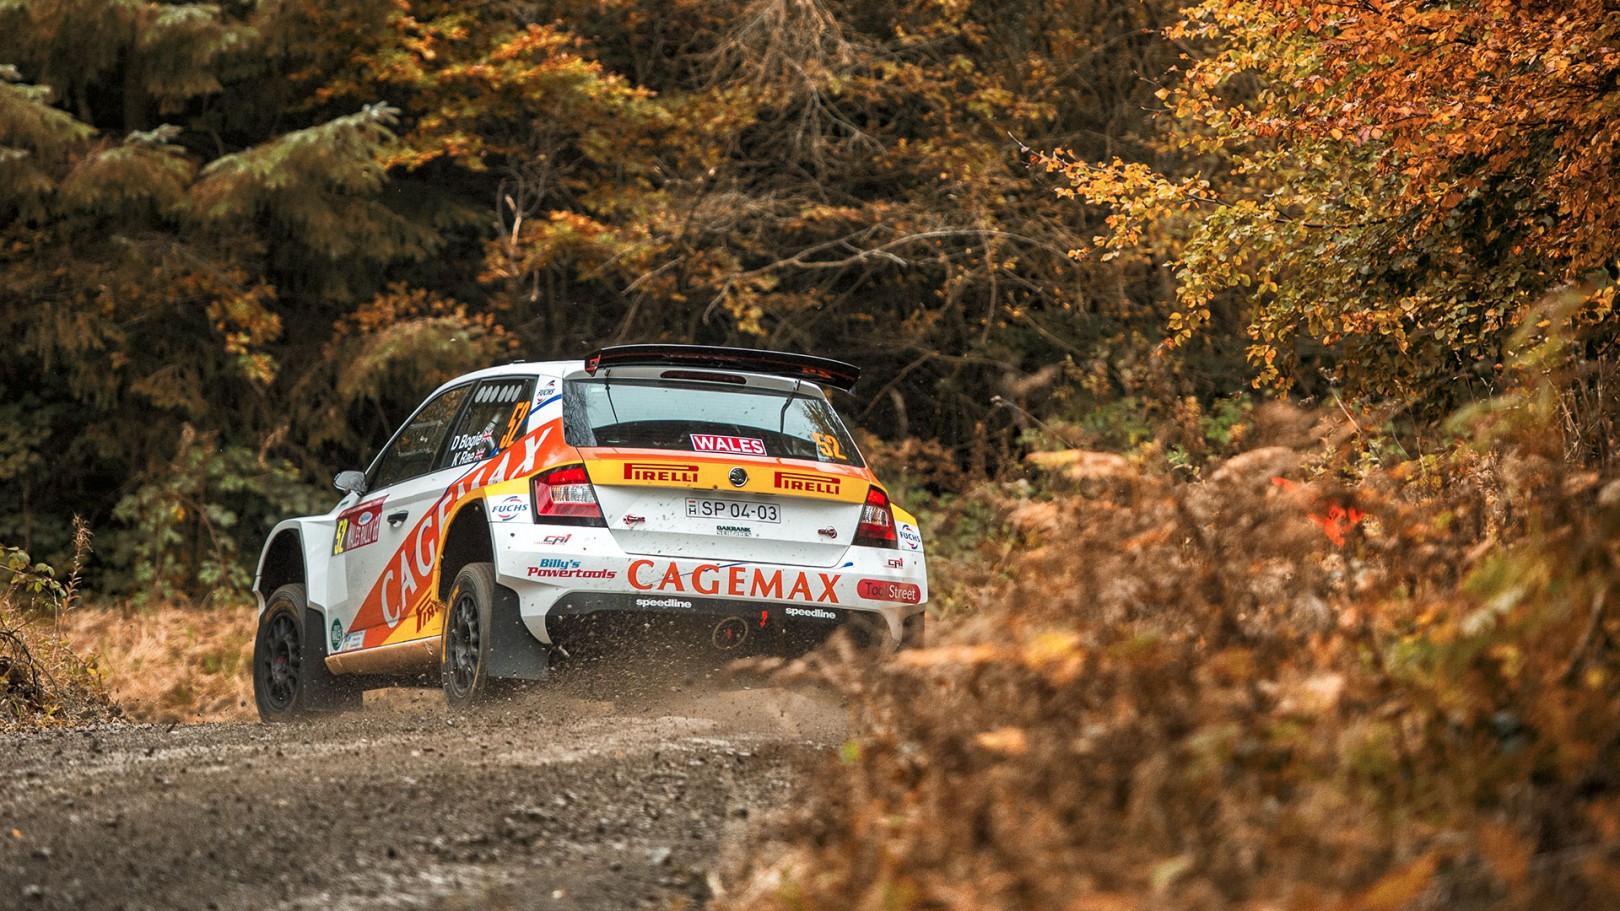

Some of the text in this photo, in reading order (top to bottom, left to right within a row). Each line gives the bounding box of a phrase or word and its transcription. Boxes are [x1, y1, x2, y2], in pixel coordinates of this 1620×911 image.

[499, 400, 531, 449] 52
[451, 431, 482, 451] D Bogie
[695, 436, 763, 454] WALES
[811, 432, 846, 460] 52
[451, 451, 475, 467] K Rae
[624, 463, 699, 482] PIRELLI
[774, 471, 840, 495] PIRELLI
[492, 504, 528, 513] FUCHS
[702, 501, 726, 516] SP
[731, 503, 777, 520] 04-03
[335, 519, 348, 555] 52
[900, 531, 920, 542] FUCHS
[540, 558, 580, 569] Billy's
[528, 567, 617, 579] Powertools
[627, 559, 841, 603] CAGEMAX
[889, 584, 916, 600] Street
[636, 598, 692, 608] speedline
[785, 606, 836, 619] speedline
